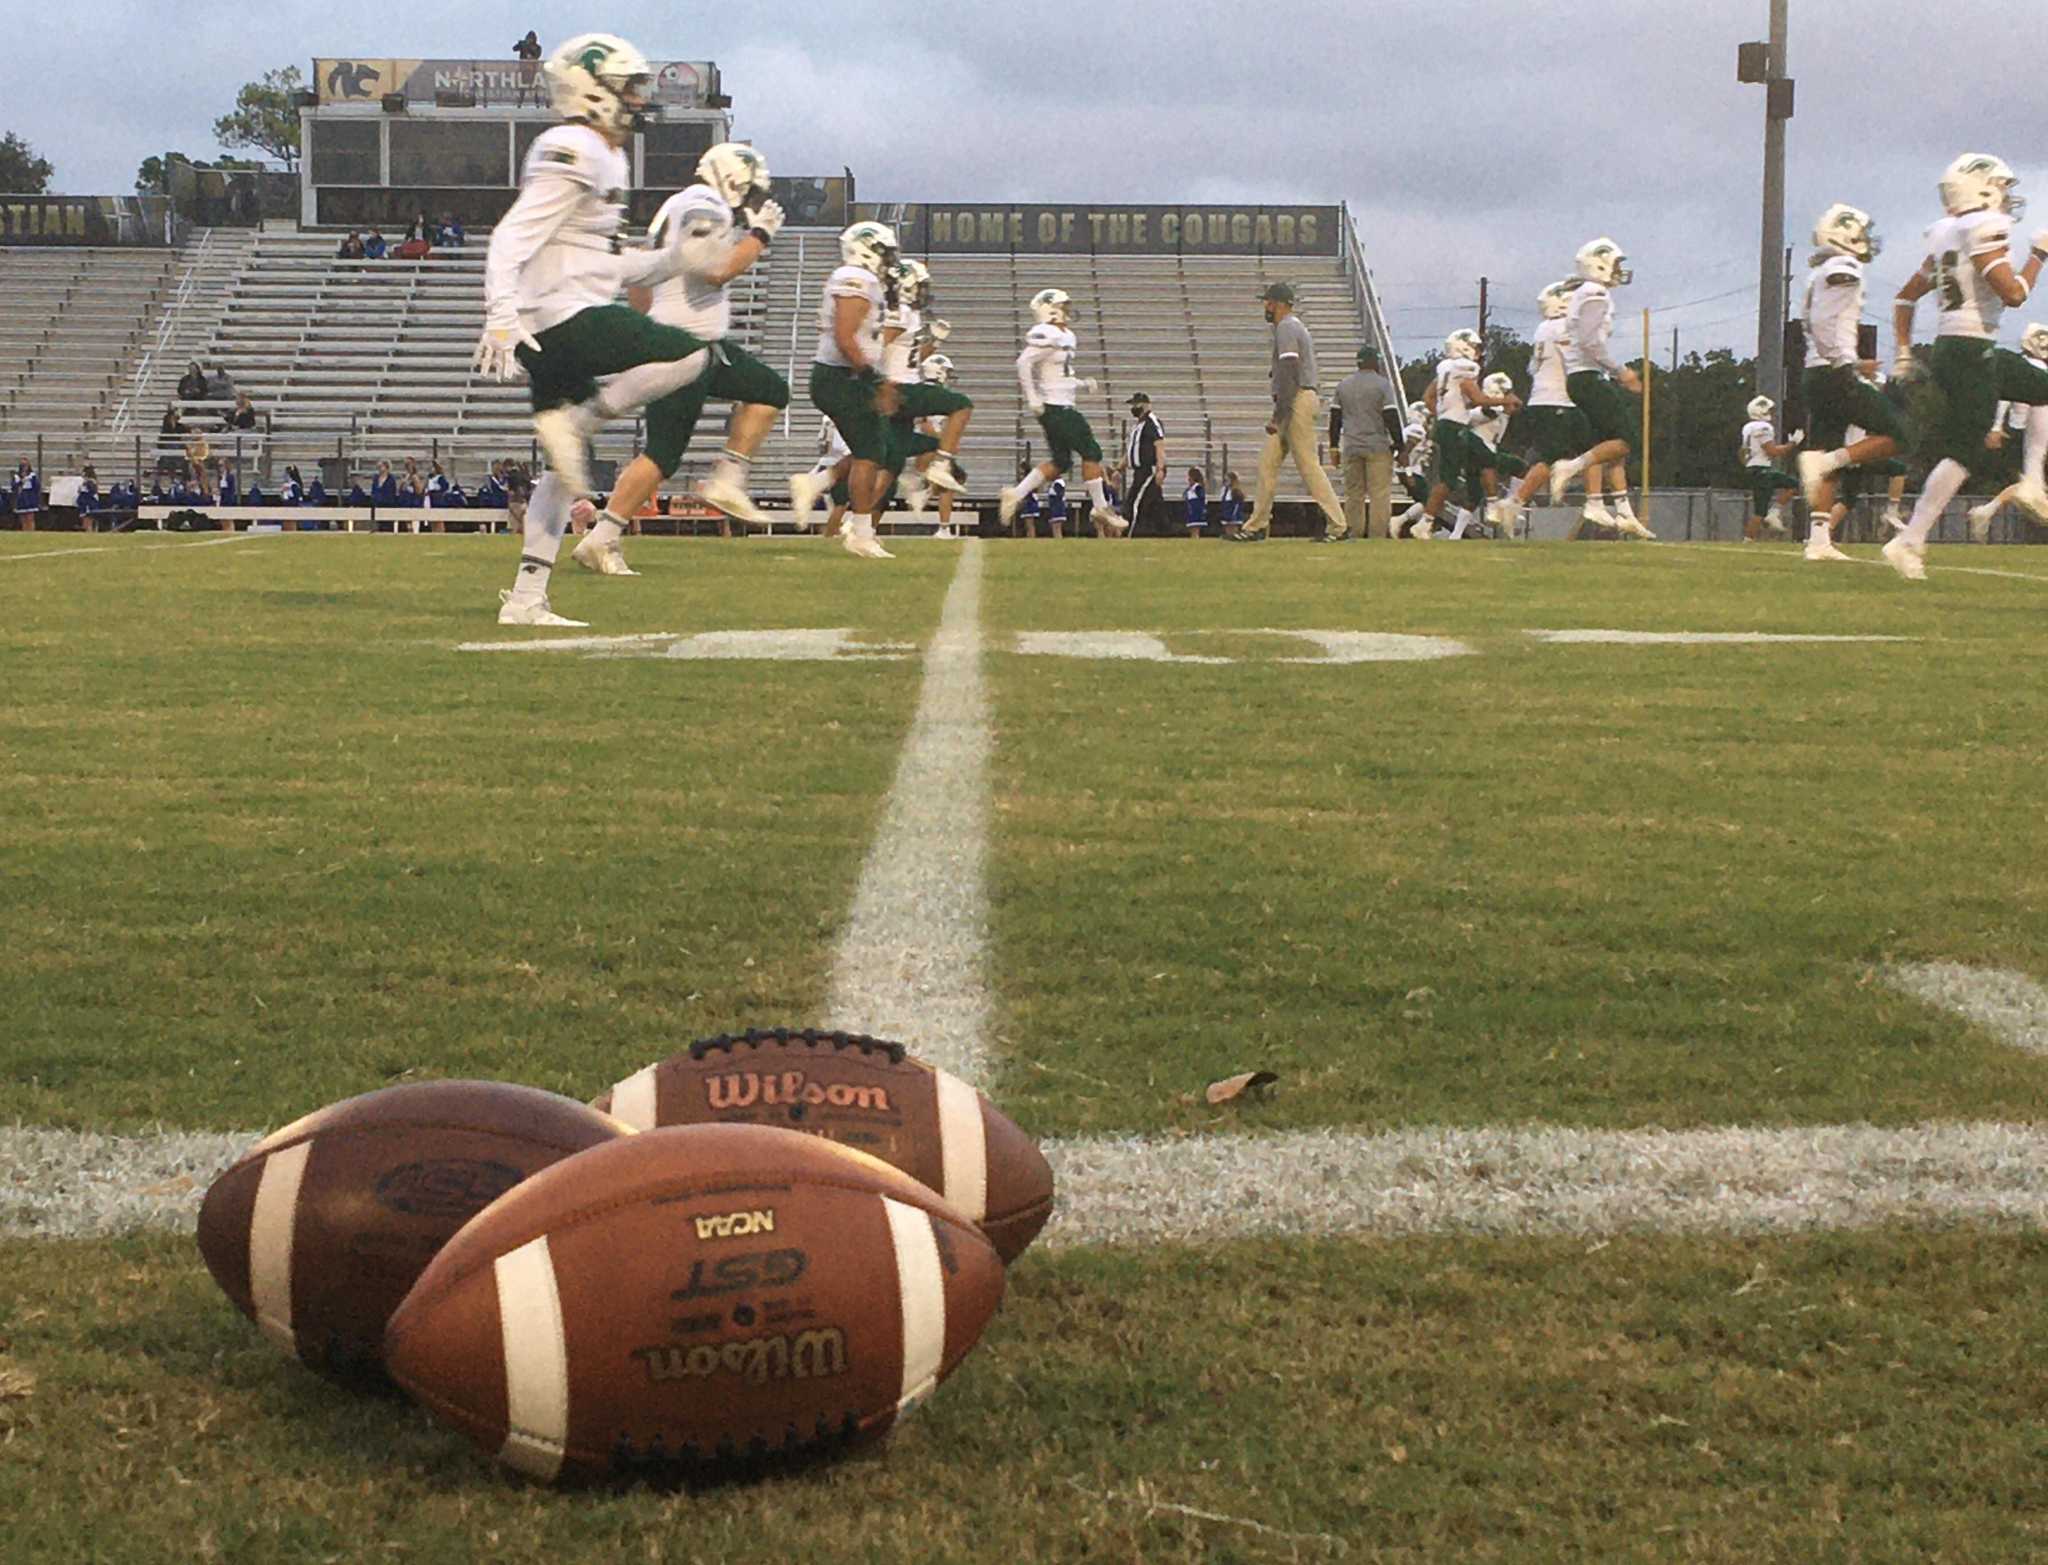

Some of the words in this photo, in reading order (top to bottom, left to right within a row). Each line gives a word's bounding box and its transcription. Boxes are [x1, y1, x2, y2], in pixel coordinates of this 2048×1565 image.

[0, 204, 85, 236] TIAN
[932, 212, 1024, 243] HOME
[1038, 212, 1075, 243] OF
[1088, 213, 1147, 244] THE
[1161, 213, 1317, 245] COUGARS
[705, 1070, 891, 1112] Wilson
[693, 1208, 776, 1240] NCAA
[671, 1247, 810, 1301] GST
[648, 1327, 849, 1383] Wilson
